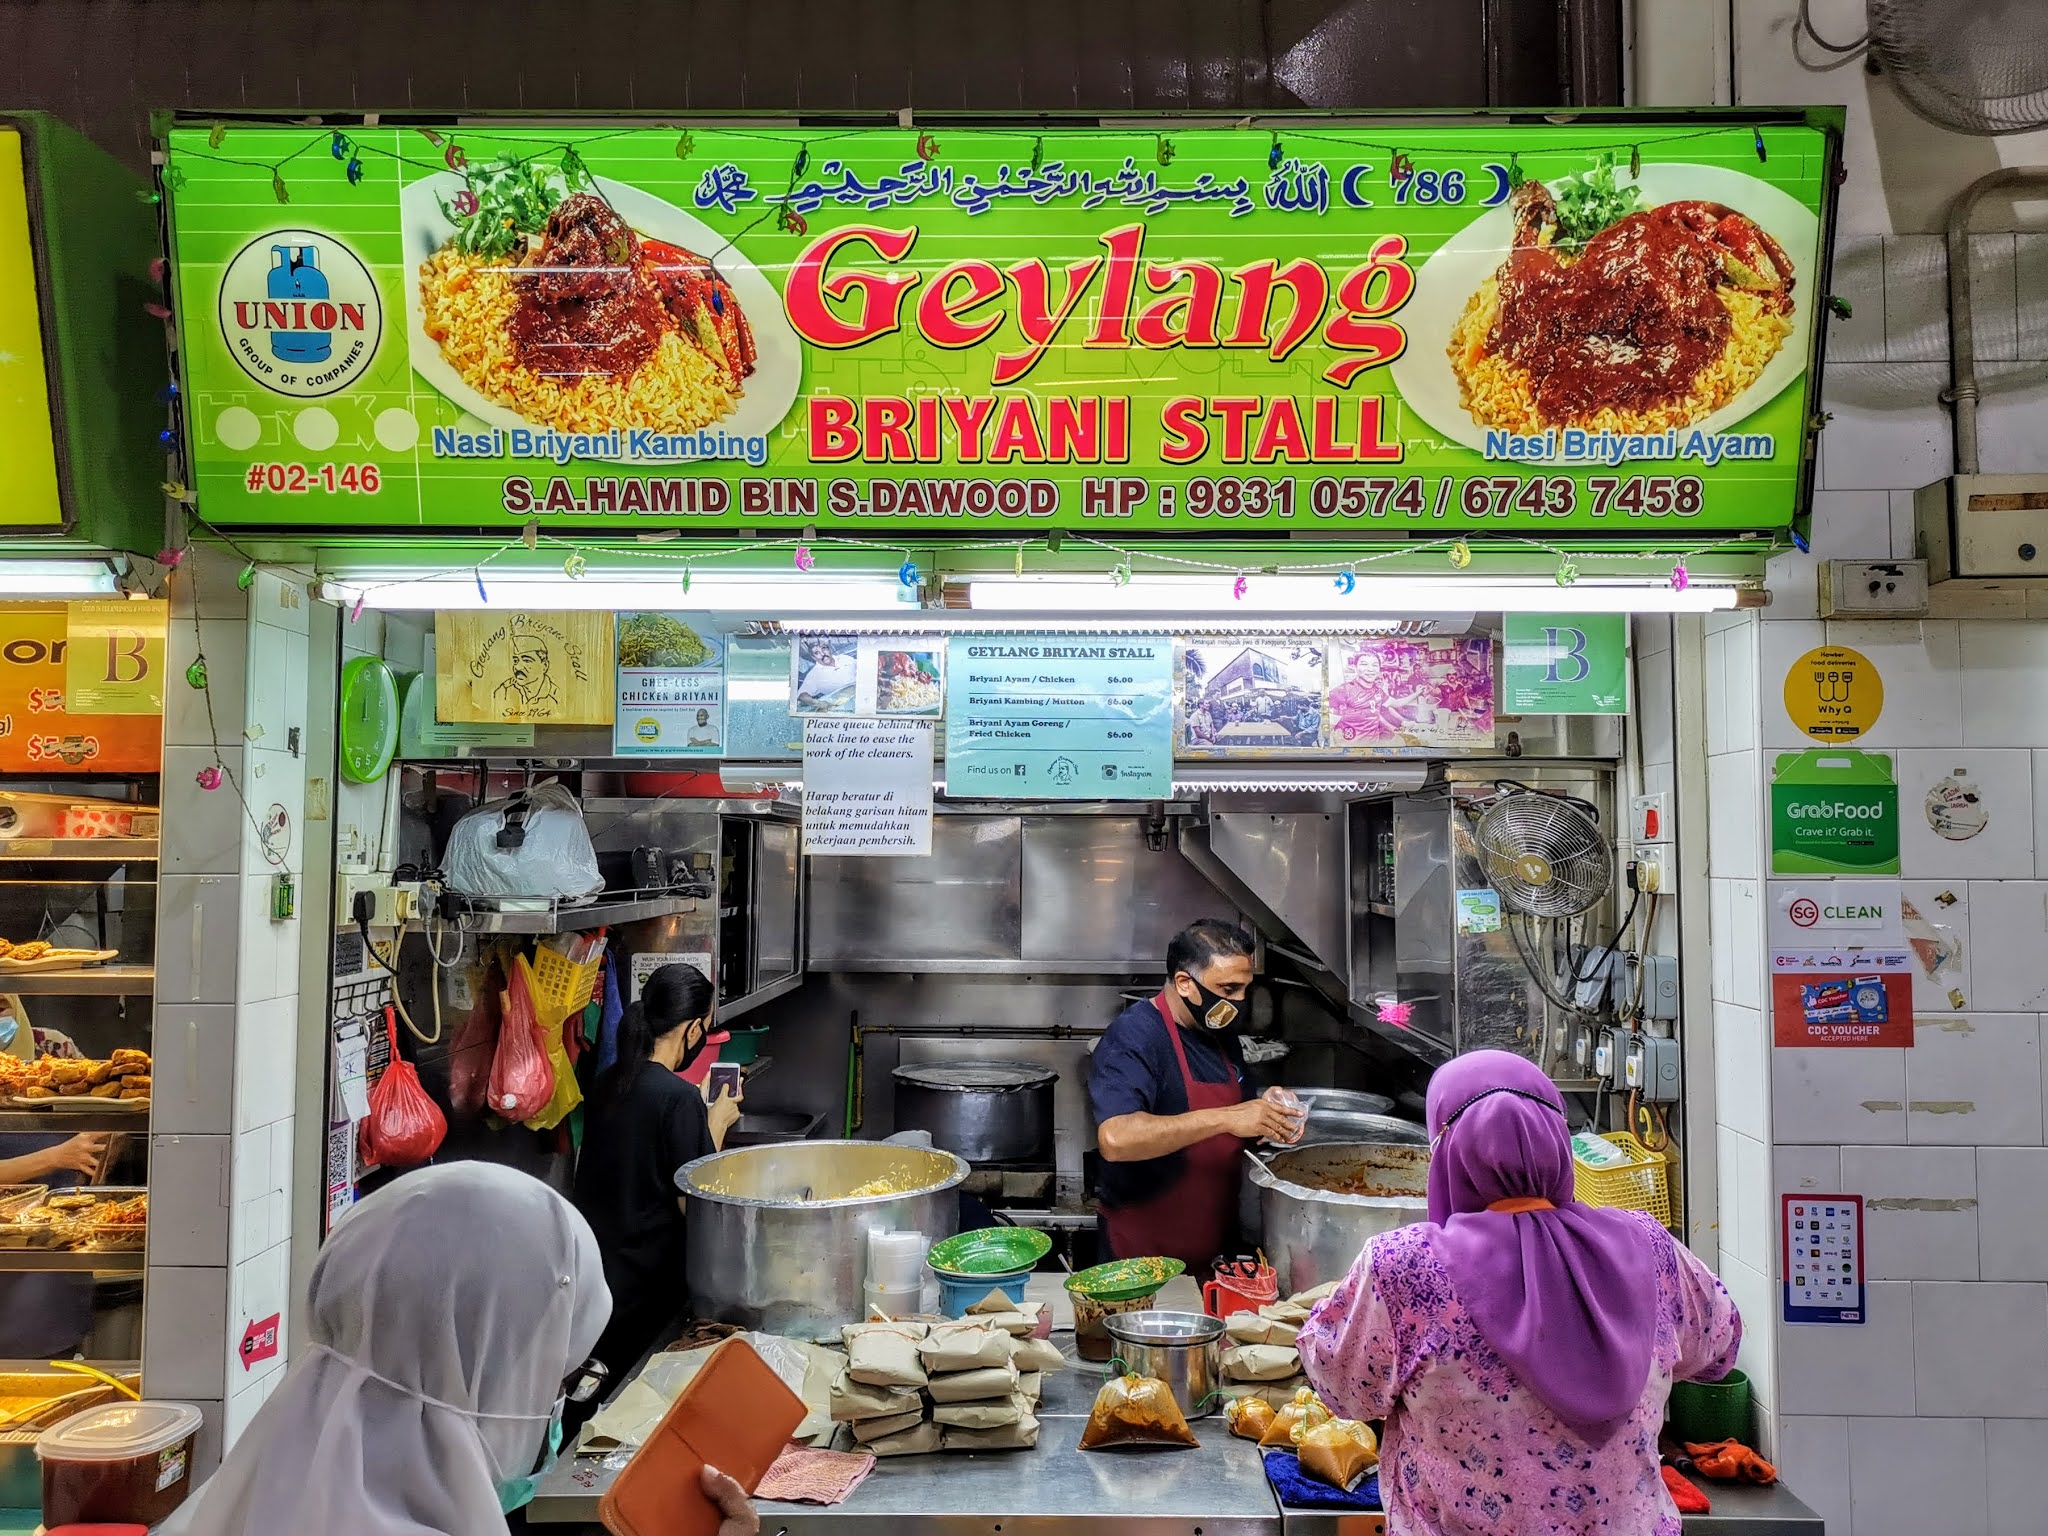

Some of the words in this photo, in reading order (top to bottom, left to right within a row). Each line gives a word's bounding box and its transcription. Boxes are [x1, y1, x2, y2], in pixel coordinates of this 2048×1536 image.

[1390, 168, 1466, 204] 786
[784, 222, 1416, 388] Geylang
[233, 301, 366, 331] UNION
[239, 337, 274, 376] GROUP
[280, 373, 298, 385] OF
[306, 338, 365, 387] COMPANIES
[808, 396, 1130, 463] BRIYANI
[1160, 395, 1403, 463] STALL
[433, 426, 507, 457] Nasi
[514, 427, 620, 465] Briyani
[629, 428, 767, 466] Kambing
[1485, 429, 1554, 459] Nasi
[1563, 429, 1674, 468] Briyani
[1683, 430, 1774, 468] Ayam
[246, 463, 380, 493] #02-146
[502, 477, 731, 516] S.A.HAMID
[743, 479, 815, 516] BIN
[828, 479, 1060, 517] S.DAWOOD
[1084, 478, 1147, 516] HP
[1187, 478, 1294, 516] 9831
[1310, 477, 1425, 516] 0574
[1433, 476, 1453, 516] /
[1462, 477, 1577, 516] 6743
[1590, 475, 1703, 515] 7458
[469, 626, 506, 679] Geylang
[510, 613, 566, 641] Briyani
[563, 641, 588, 682] Stall
[967, 646, 1040, 658] GEYLANG
[1042, 647, 1106, 658] BRIYANI
[1108, 648, 1155, 659] STALL
[101, 628, 149, 684] B
[1539, 626, 1591, 683] B
[969, 675, 1003, 684] Briyani
[1004, 676, 1031, 684] Ayam
[1038, 675, 1075, 683] Chicken
[1107, 676, 1133, 684] $6.00
[622, 691, 669, 701] CHICKEN
[674, 691, 719, 701] BRIYANI
[969, 697, 1002, 706] Briyani
[1004, 697, 1044, 706] Kambing
[1107, 698, 1133, 706] $6.00
[501, 707, 527, 717] Since
[1818, 705, 1841, 716] Why
[1843, 705, 1852, 714] Q
[806, 719, 841, 730] Please
[842, 721, 875, 732] queue
[877, 719, 913, 730] behind
[915, 719, 933, 730] the
[968, 719, 1002, 728] Briyani
[1004, 720, 1030, 728] Ayam
[1031, 720, 1064, 728] Goreng
[805, 733, 834, 744] black
[837, 733, 857, 744] line
[859, 735, 870, 744] to
[872, 736, 896, 744] ease
[898, 734, 915, 744] the
[969, 730, 993, 738] Fried
[994, 730, 1031, 738] Chicken
[1107, 731, 1133, 739] $6.00
[806, 748, 832, 758] work
[834, 748, 848, 760] of
[848, 748, 865, 758] the
[867, 748, 914, 758] cleaners.
[967, 765, 987, 774] Find
[1120, 769, 1152, 780] Instagram
[805, 791, 839, 803] Harap
[841, 791, 881, 801] beratur
[883, 791, 894, 801] di
[805, 806, 853, 818] belakang
[854, 806, 895, 818] garisan
[897, 806, 928, 816] hitam
[1786, 800, 1883, 819] GrabFood
[805, 820, 836, 831] untuk
[838, 820, 910, 831] memudahkan
[1795, 826, 1824, 837] Crave
[1825, 826, 1837, 837] it?
[1838, 826, 1863, 837] Grab
[1865, 826, 1875, 837] it.
[804, 835, 856, 847] pekerjaan
[858, 835, 916, 848] pembersih.
[1794, 907, 1815, 919] SG
[1823, 905, 1882, 919] CLEAN
[1807, 1025, 1829, 1035] CDC
[1830, 1025, 1880, 1035] VOUCHER
